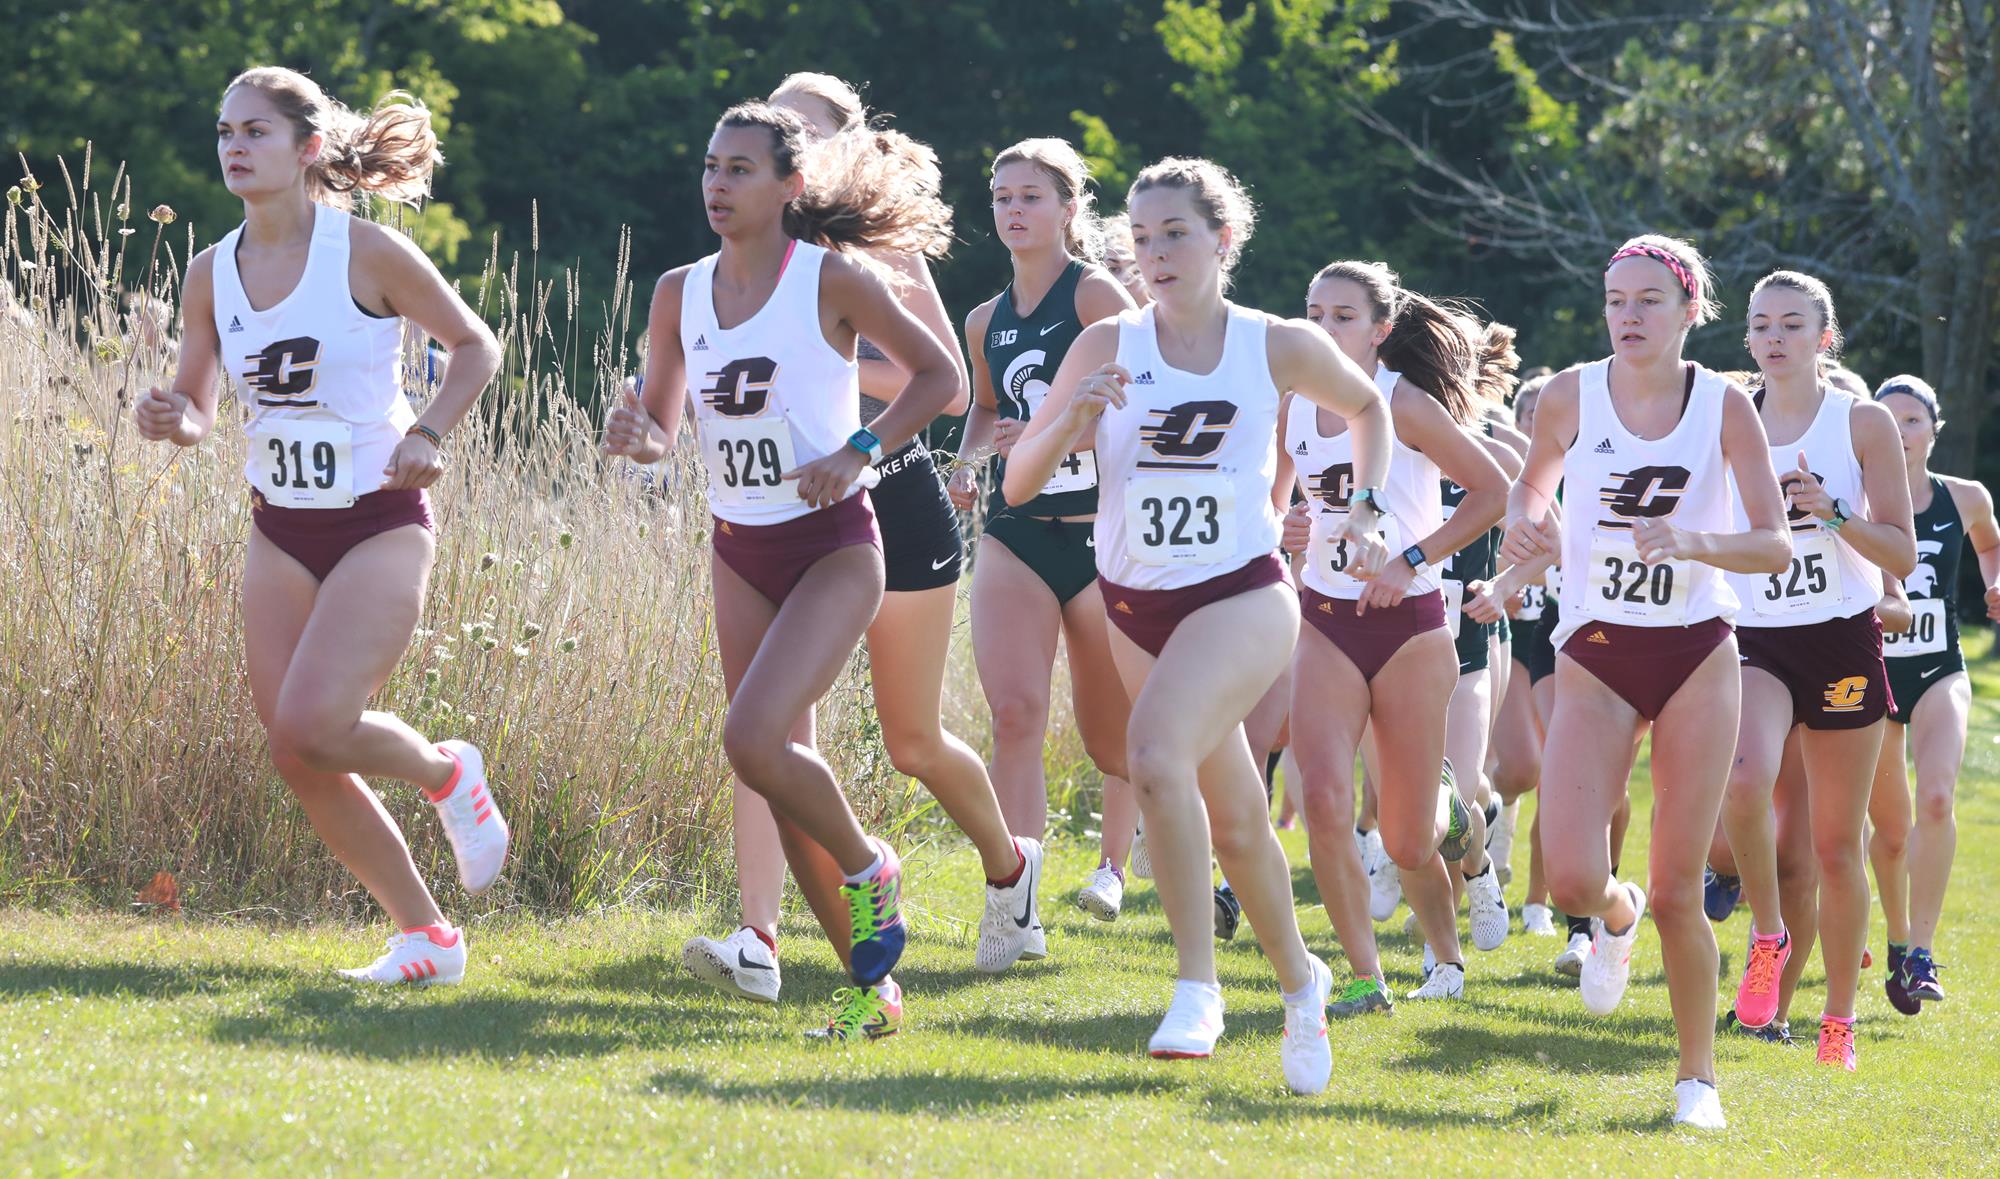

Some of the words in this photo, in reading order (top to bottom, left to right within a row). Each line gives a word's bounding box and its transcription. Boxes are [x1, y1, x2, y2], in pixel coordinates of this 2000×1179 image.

[268, 438, 336, 490] 319
[718, 438, 782, 488] 329
[903, 443, 923, 468] PRO
[1141, 495, 1220, 547] 323
[1602, 556, 1674, 606] 320
[1764, 552, 1828, 601] 325
